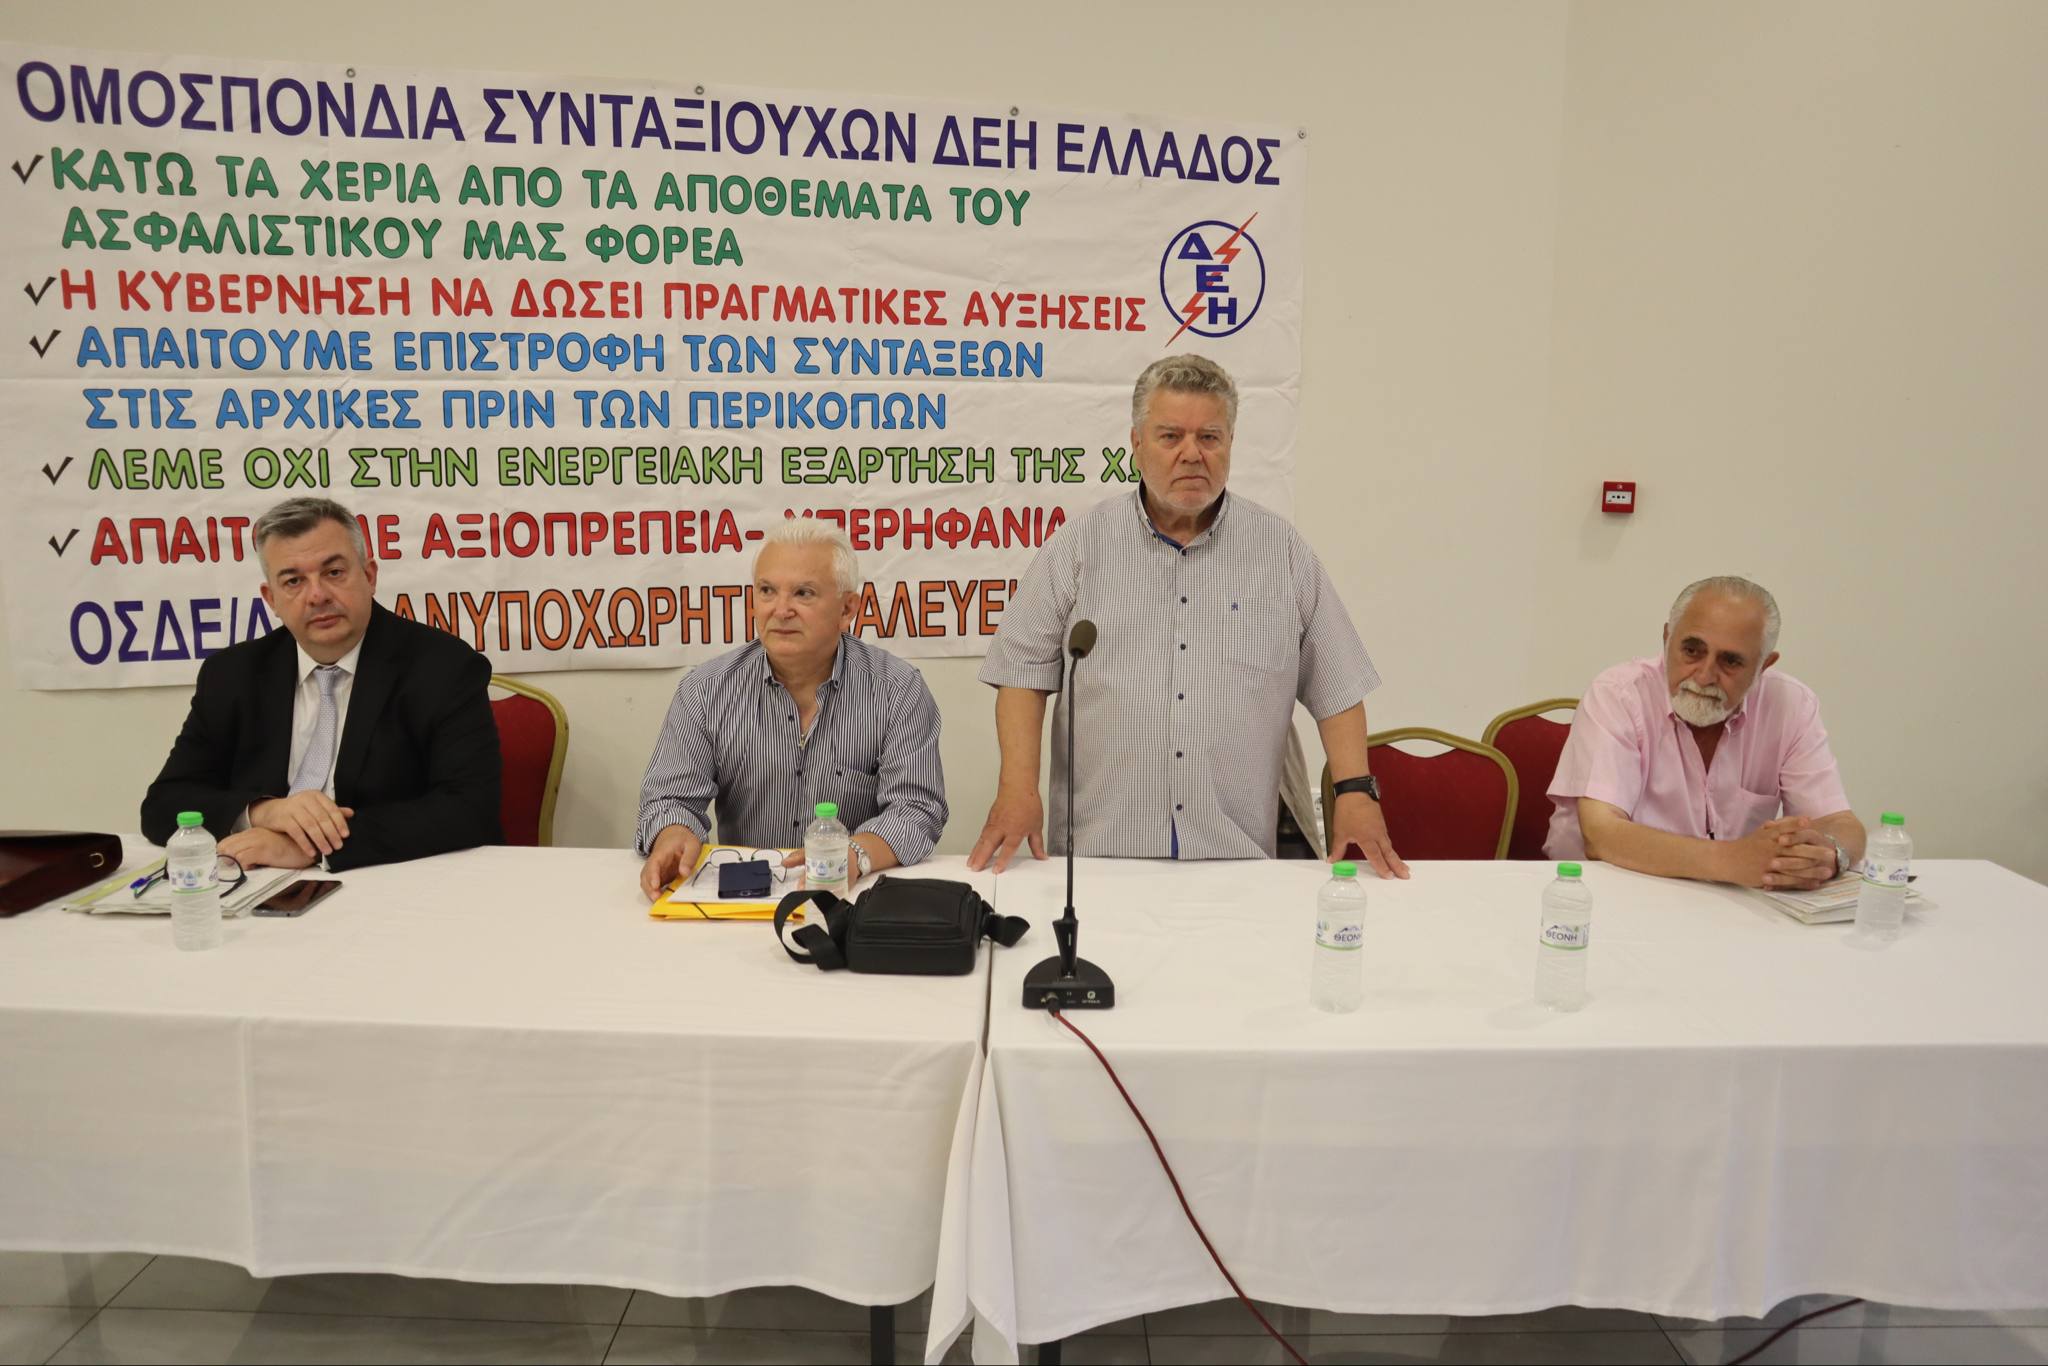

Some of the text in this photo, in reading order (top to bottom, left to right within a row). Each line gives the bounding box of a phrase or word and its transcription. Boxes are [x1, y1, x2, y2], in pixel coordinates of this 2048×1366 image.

[17, 62, 1280, 185] ΟΜΟΣΠΟΝΔΙΑ ΣΥΝΤΑΞΙΟΥΧΩΝ ΔΕΗ ΕΛΛΑΔΟΣ
[51, 147, 1030, 226] ΚΑΤΩ ΤΑ ΧΕΡΙΑ ΑΠΟ ΤΑ ΑΠΟΘΕΜΑΤΑ ΤΟΥ
[62, 207, 743, 266] ΑΣΦΑΛΙΣΤΙΚΟΥ ΜΑΣ ΦΟΡΕΑ
[61, 269, 1146, 331] Η ΚΥΒΕΡΝΗΣΗ ΝΑ ΔΩΣΕΙ ΠΡΑΓΜΑΤΙΚΕΣ ΑΥΞΗΣΕΙΣ
[77, 326, 1042, 377] ΑΠΑΙΤΟΥΜΕ ΕΠΙΣΤΡΟΦΗ ΤΩΝ ΣΥΝΤΑΞΕΩΝ
[83, 389, 945, 429] ΣΤΙΣ ΑΡΧΙΚΕΣ ΠΡΙΝ ΤΩΝ ΠΕΡΙΚΟΠΩΝ
[88, 448, 224, 490] ΛΕΜΕ
[244, 448, 330, 489] ΟΧΙ
[349, 447, 478, 487] ΣΤΗΝ
[498, 446, 762, 486] ΕΝΕΡΓΕΙΑΚΗ
[782, 447, 994, 484] ΕΞΑΡΤΗΣΗ
[1011, 448, 1085, 483] ΤΗΣ
[91, 514, 402, 566] ΑΠΑΙΤΕ
[784, 506, 1066, 552] ΕΡΗΦΑΝΙΑ
[848, 579, 1018, 639] ΑΛΕΥΕ
